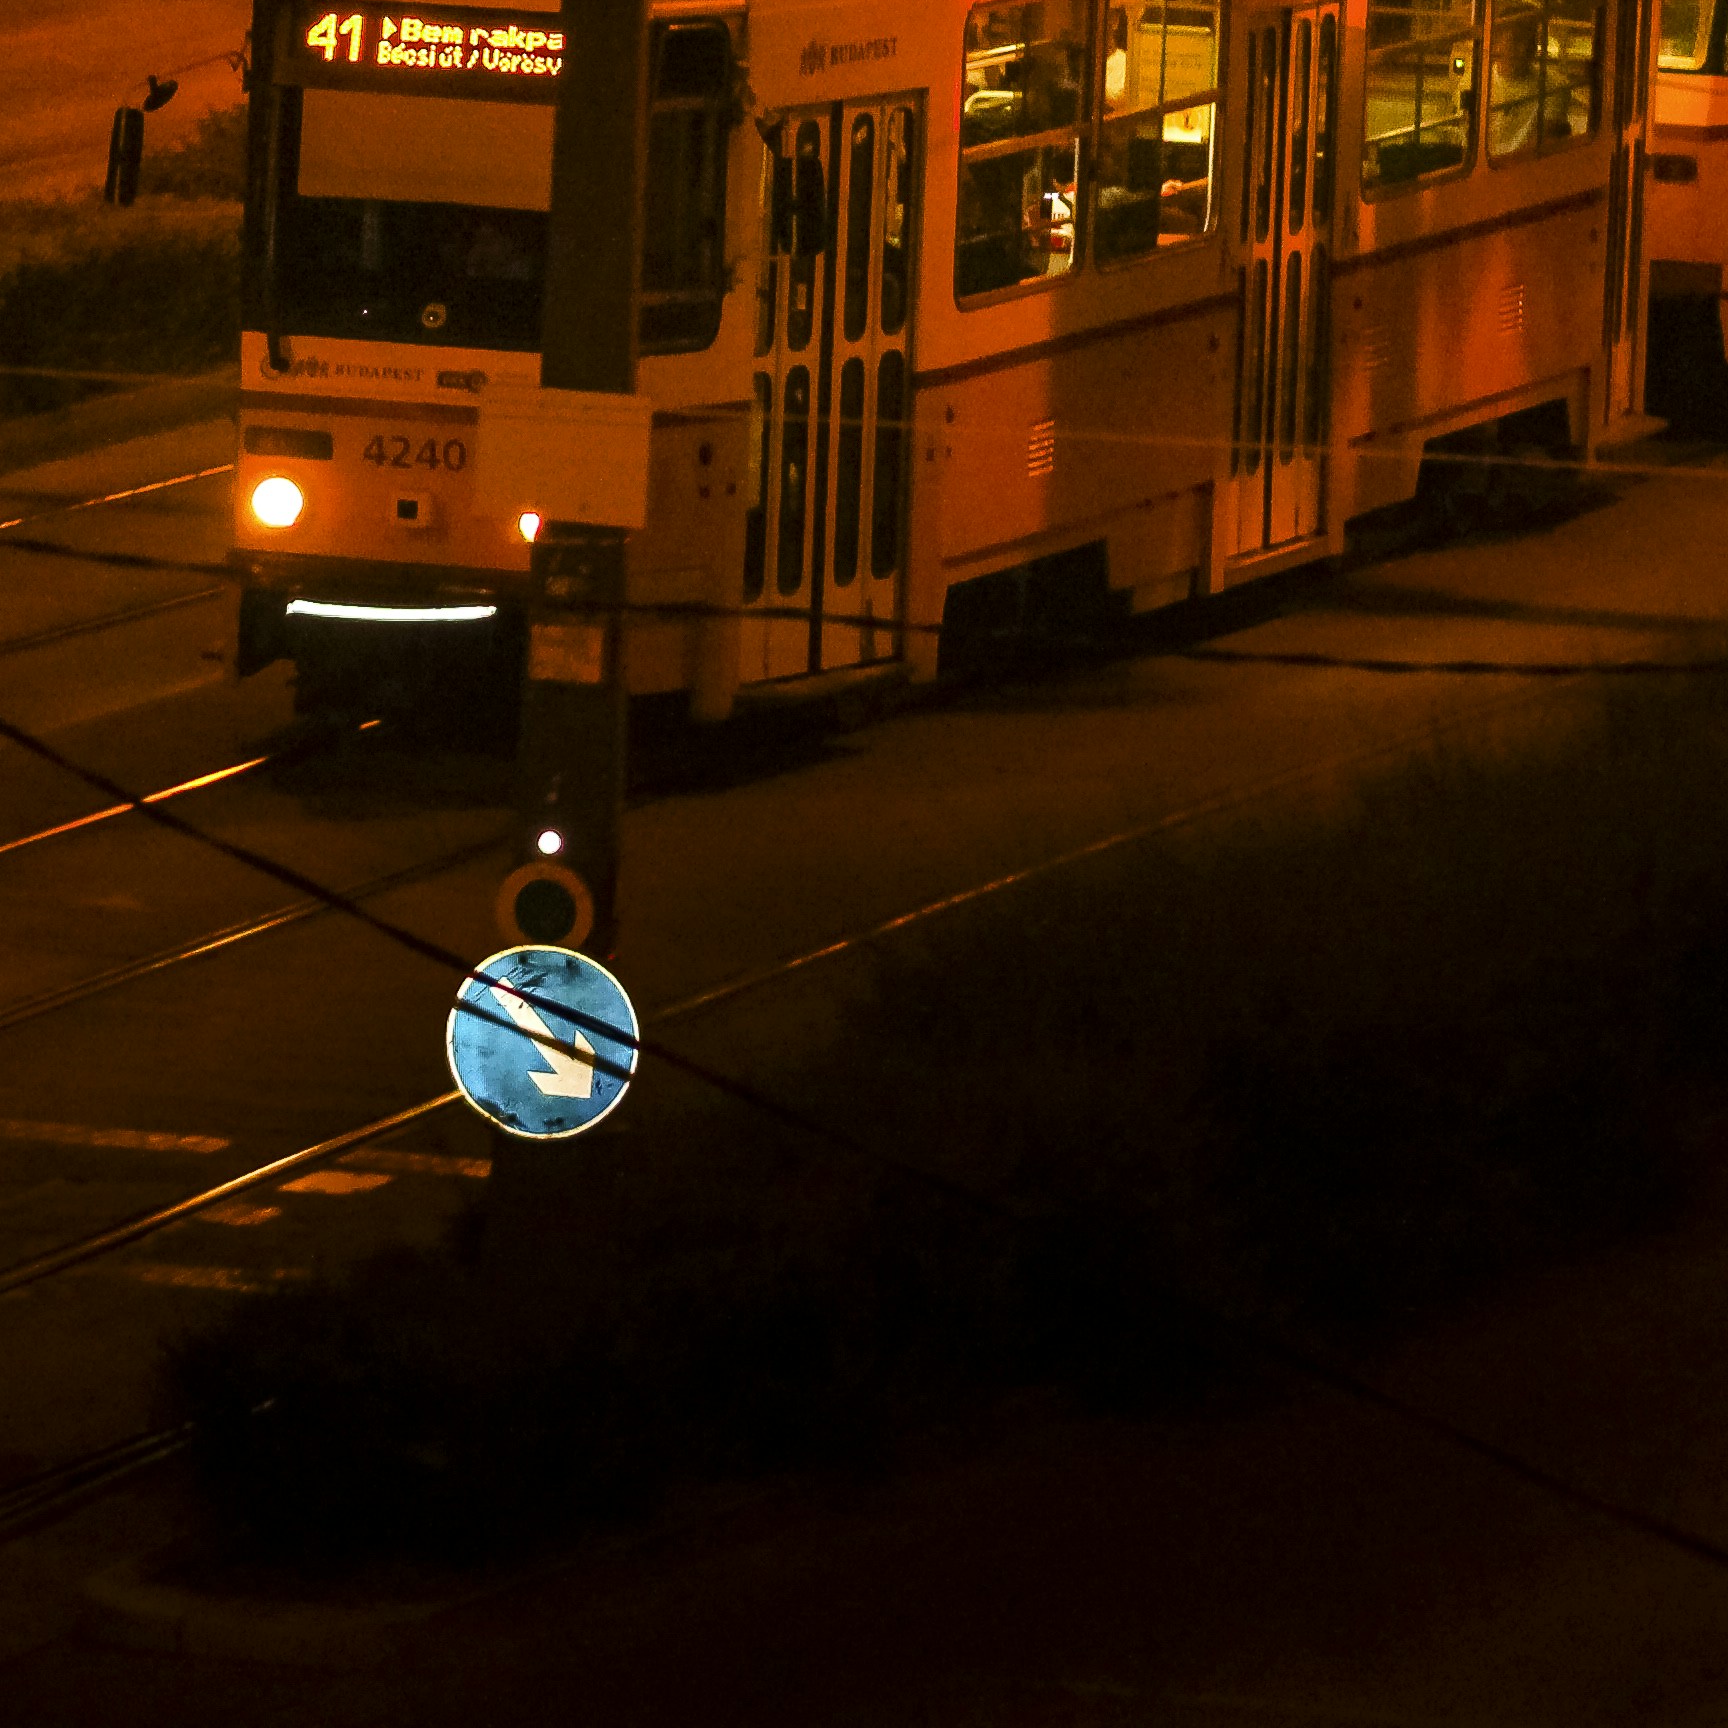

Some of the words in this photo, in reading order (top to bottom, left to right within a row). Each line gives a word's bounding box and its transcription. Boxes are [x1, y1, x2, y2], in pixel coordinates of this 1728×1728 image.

[307, 13, 364, 62] 41
[400, 17, 464, 45] Bem
[362, 435, 467, 471] 4240
